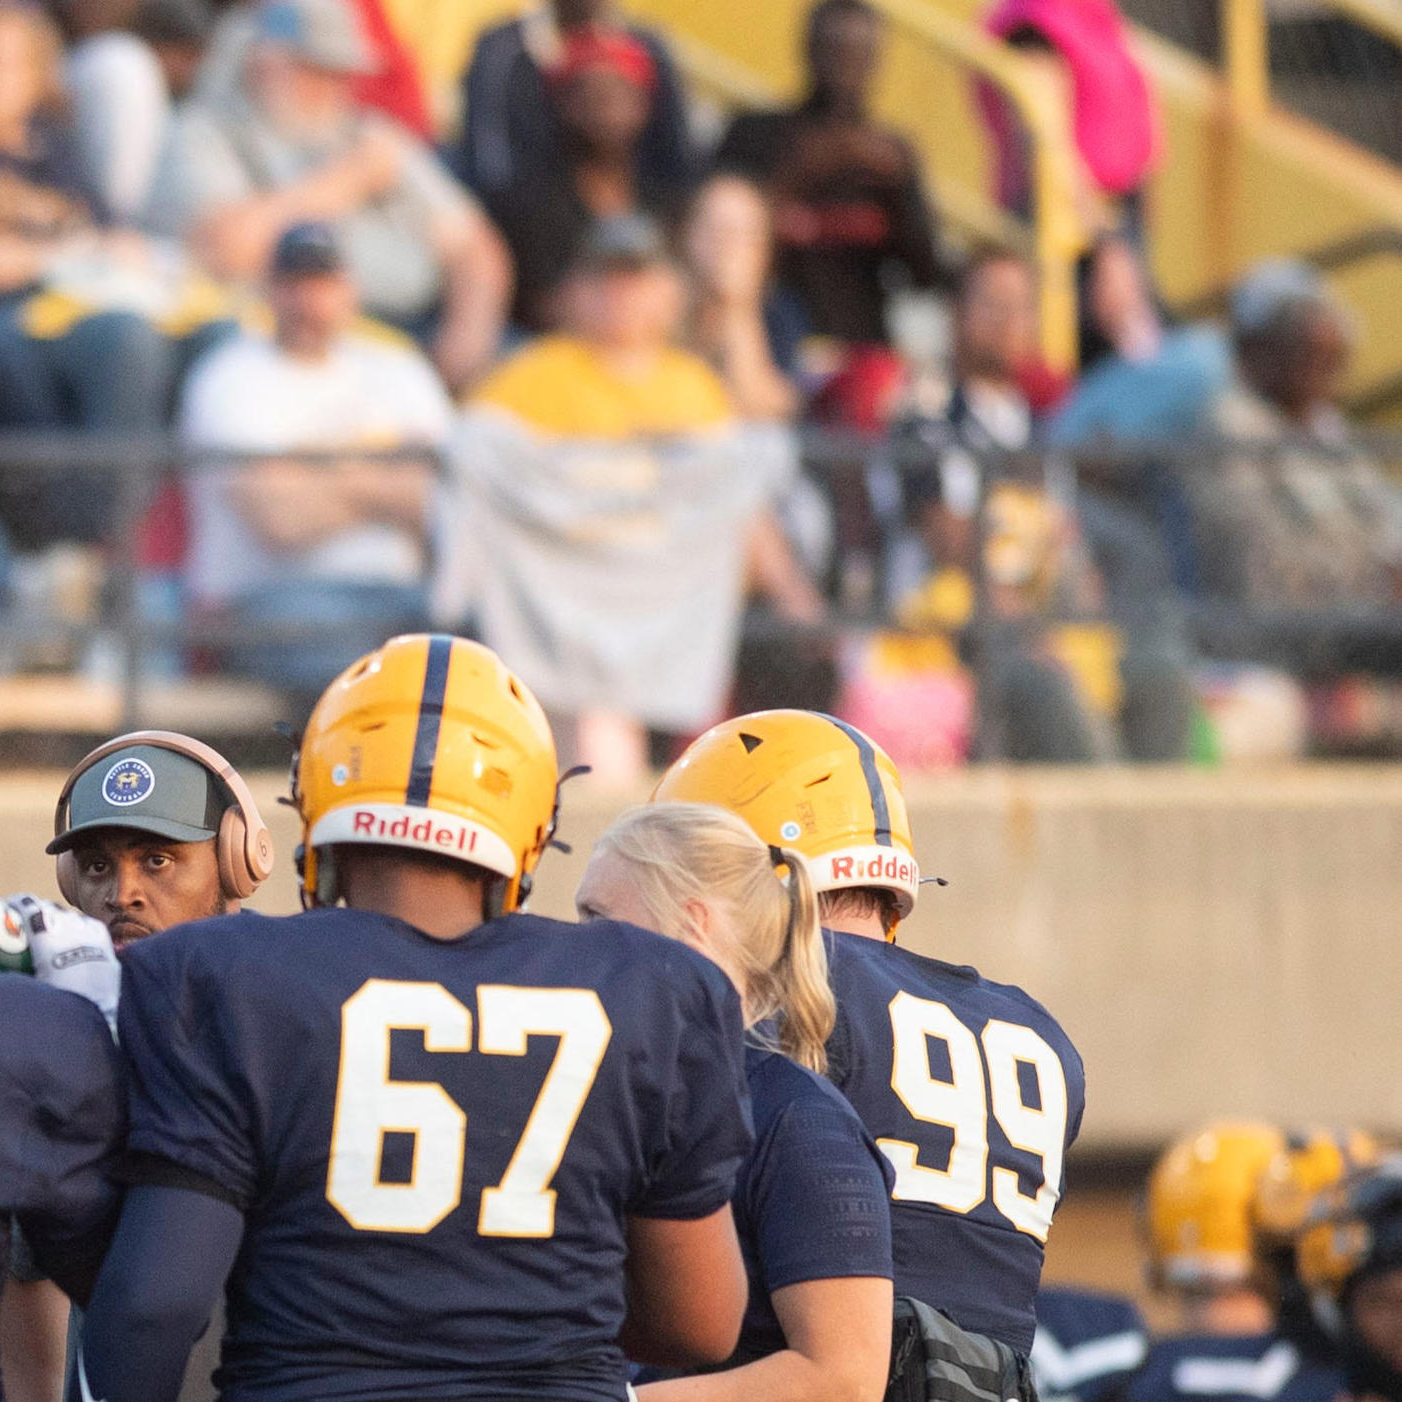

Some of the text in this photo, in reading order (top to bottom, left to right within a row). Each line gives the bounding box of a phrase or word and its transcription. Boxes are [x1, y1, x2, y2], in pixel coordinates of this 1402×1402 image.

[353, 811, 478, 853] Riddell
[325, 978, 613, 1238] 67
[876, 990, 1068, 1244] 99
